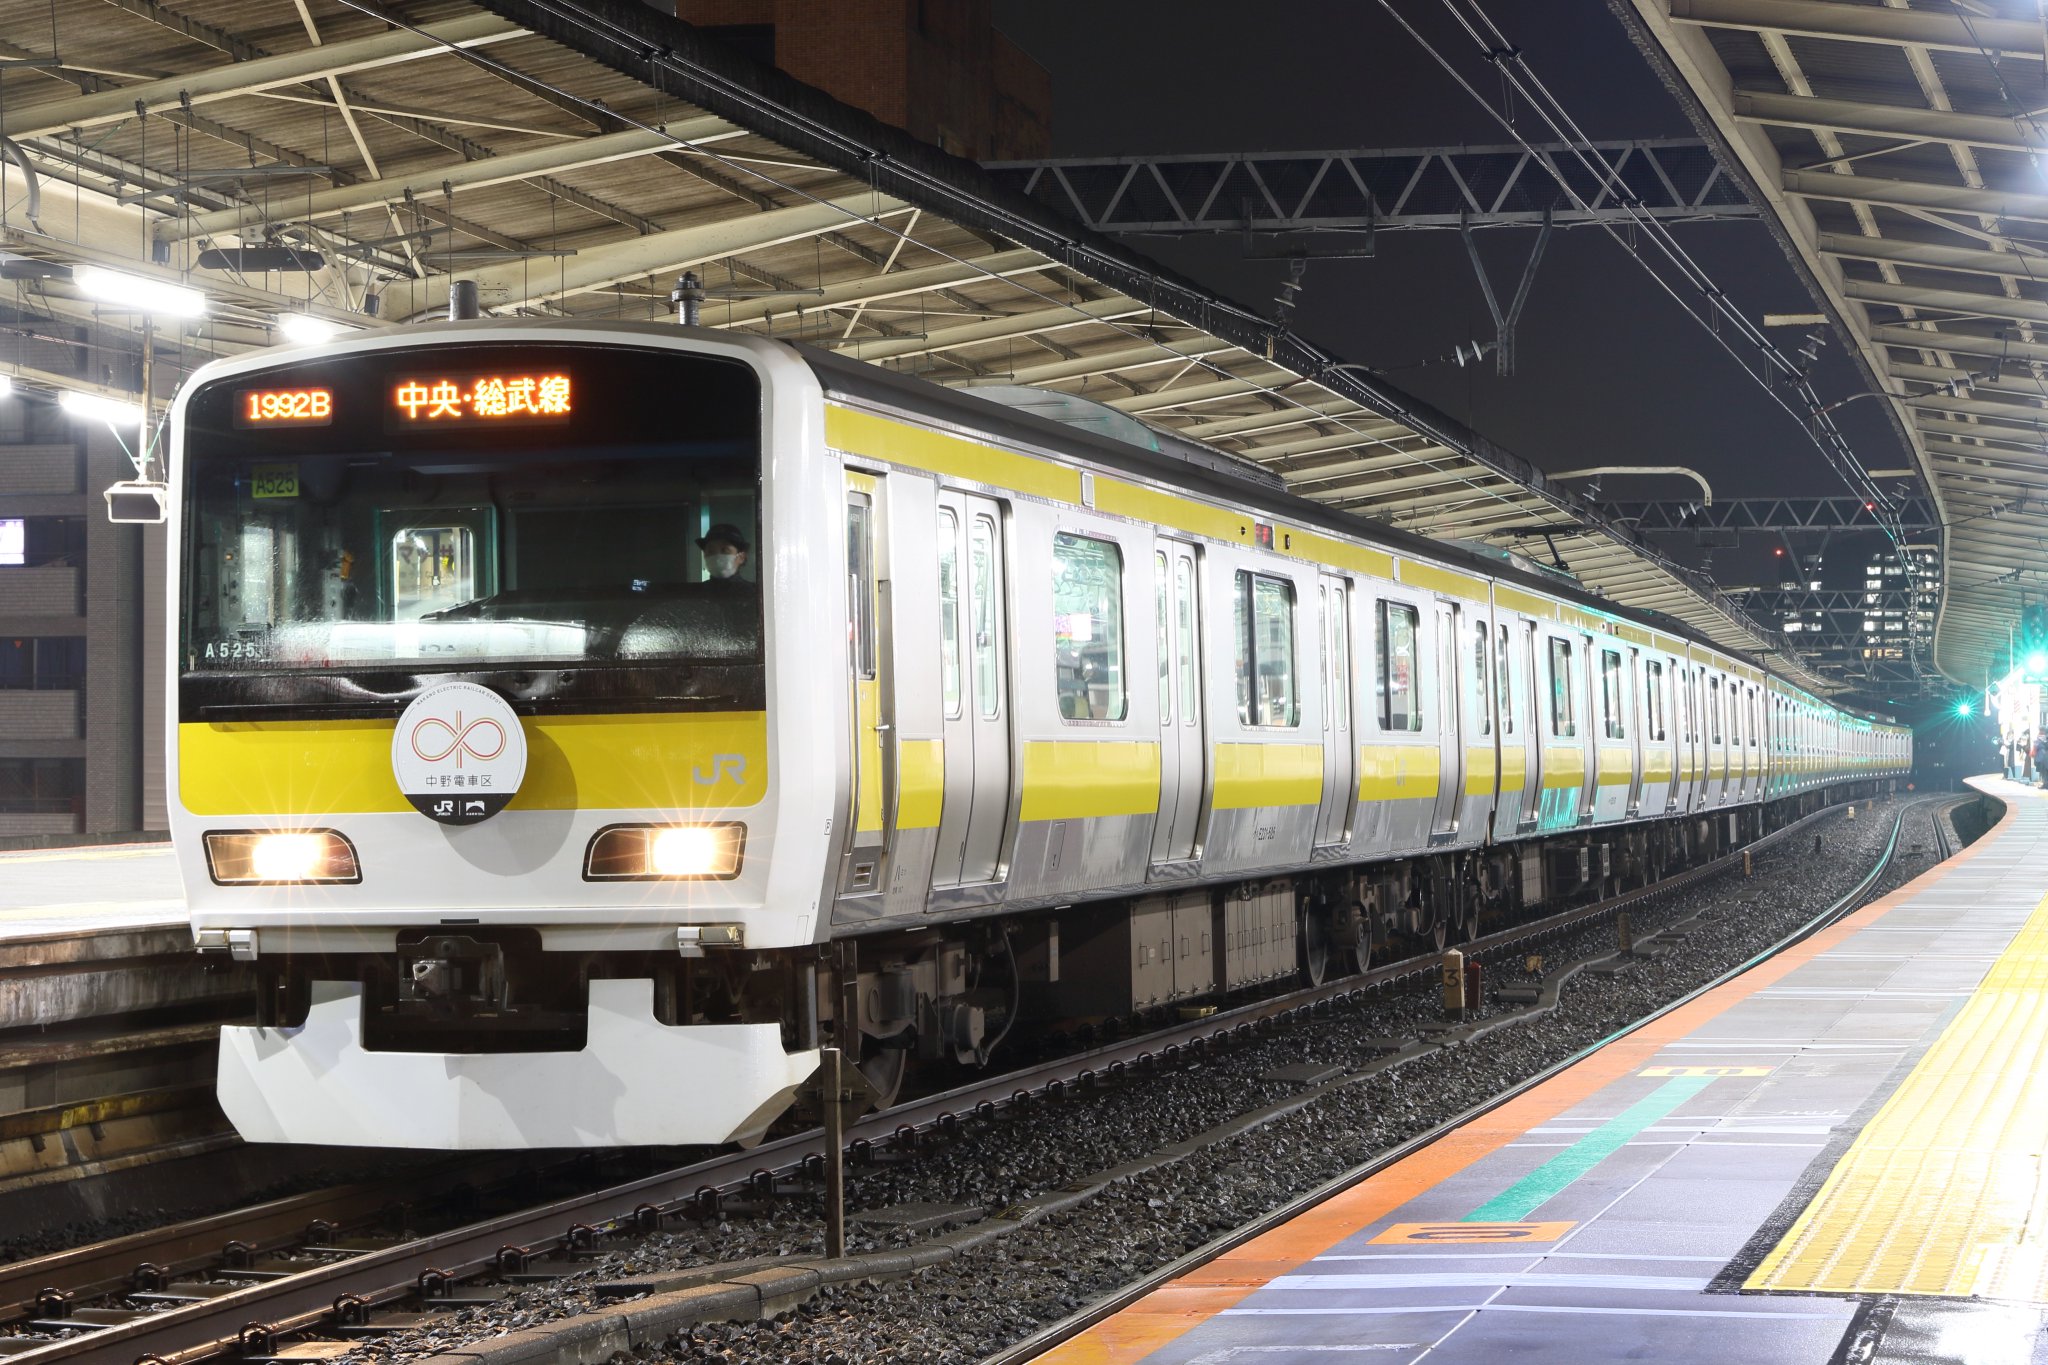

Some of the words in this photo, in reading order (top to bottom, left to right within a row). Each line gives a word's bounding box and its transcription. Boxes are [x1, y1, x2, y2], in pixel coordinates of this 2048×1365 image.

[250, 391, 330, 420] 1992B
[397, 376, 571, 418] 中央・総武線
[256, 472, 295, 495] A525
[205, 642, 255, 658] A525
[416, 691, 436, 706] NAKANO
[437, 685, 462, 694] ELECTRIC
[463, 685, 485, 695] RAILCAR
[485, 693, 502, 705] DEPOT
[692, 753, 746, 785] JR
[426, 774, 492, 788] 中野電車区
[433, 800, 454, 813] JR
[1445, 968, 1460, 988] 3
